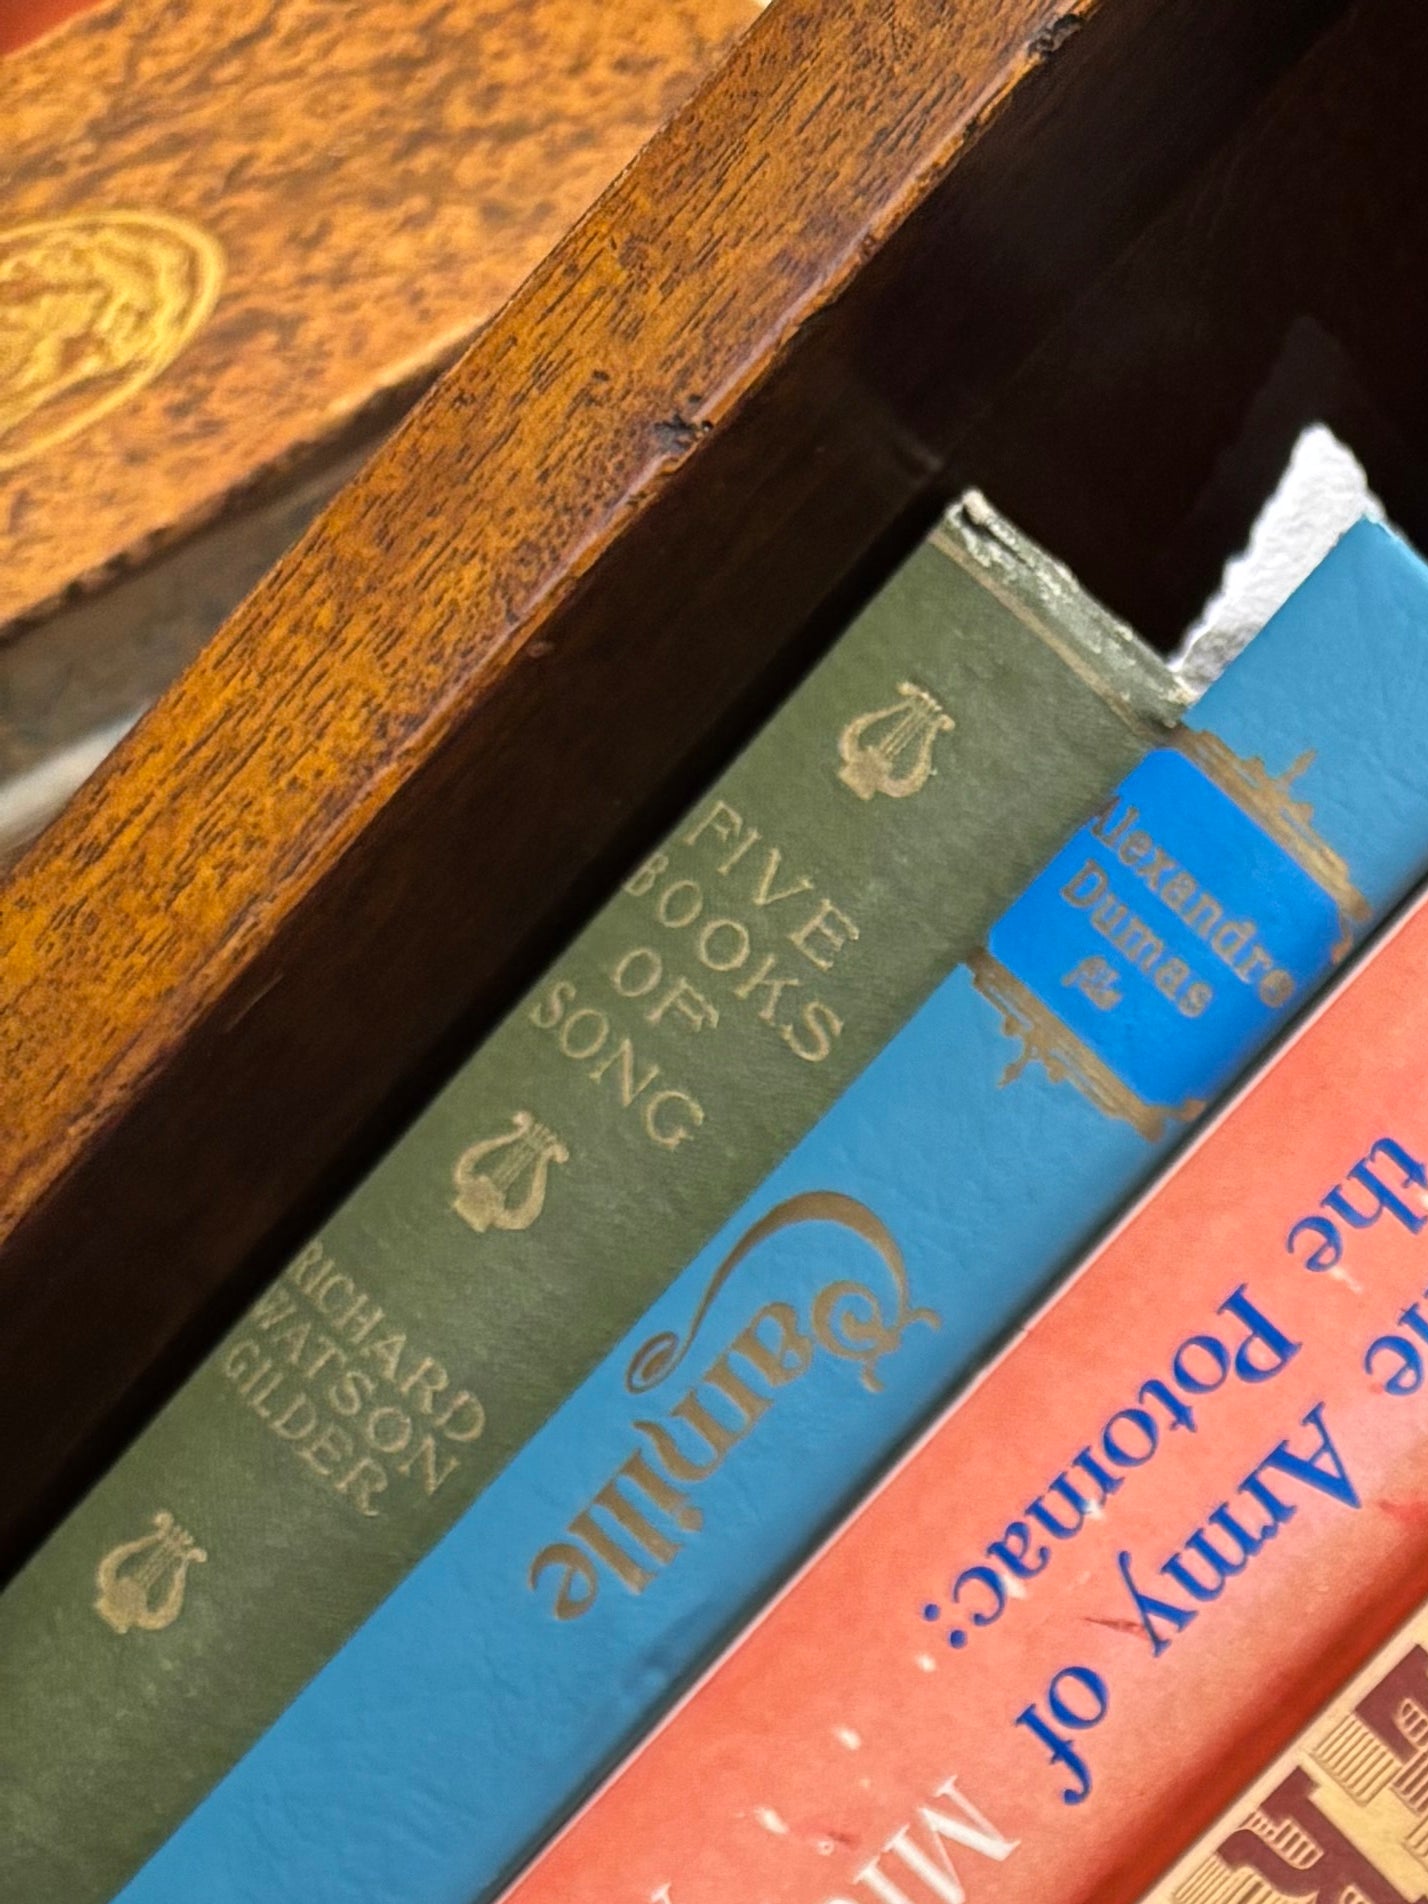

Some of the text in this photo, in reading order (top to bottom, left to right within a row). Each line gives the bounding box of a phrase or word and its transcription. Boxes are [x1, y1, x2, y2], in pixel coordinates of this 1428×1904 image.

[620, 854, 845, 1066] BOOKS
[682, 802, 862, 971] FIVE
[1061, 859, 1214, 1019] Dumas
[528, 979, 706, 1154] SONG
[613, 948, 722, 1036] OF
[218, 1332, 382, 1520] GILDER
[249, 1291, 463, 1500] WATSON
[292, 1241, 488, 1447] RICHARD
[520, 1190, 945, 1626] Camille
[923, 1283, 1303, 1651] Potomac:
[1116, 1402, 1363, 1658] Army
[1014, 1665, 1110, 1806] of
